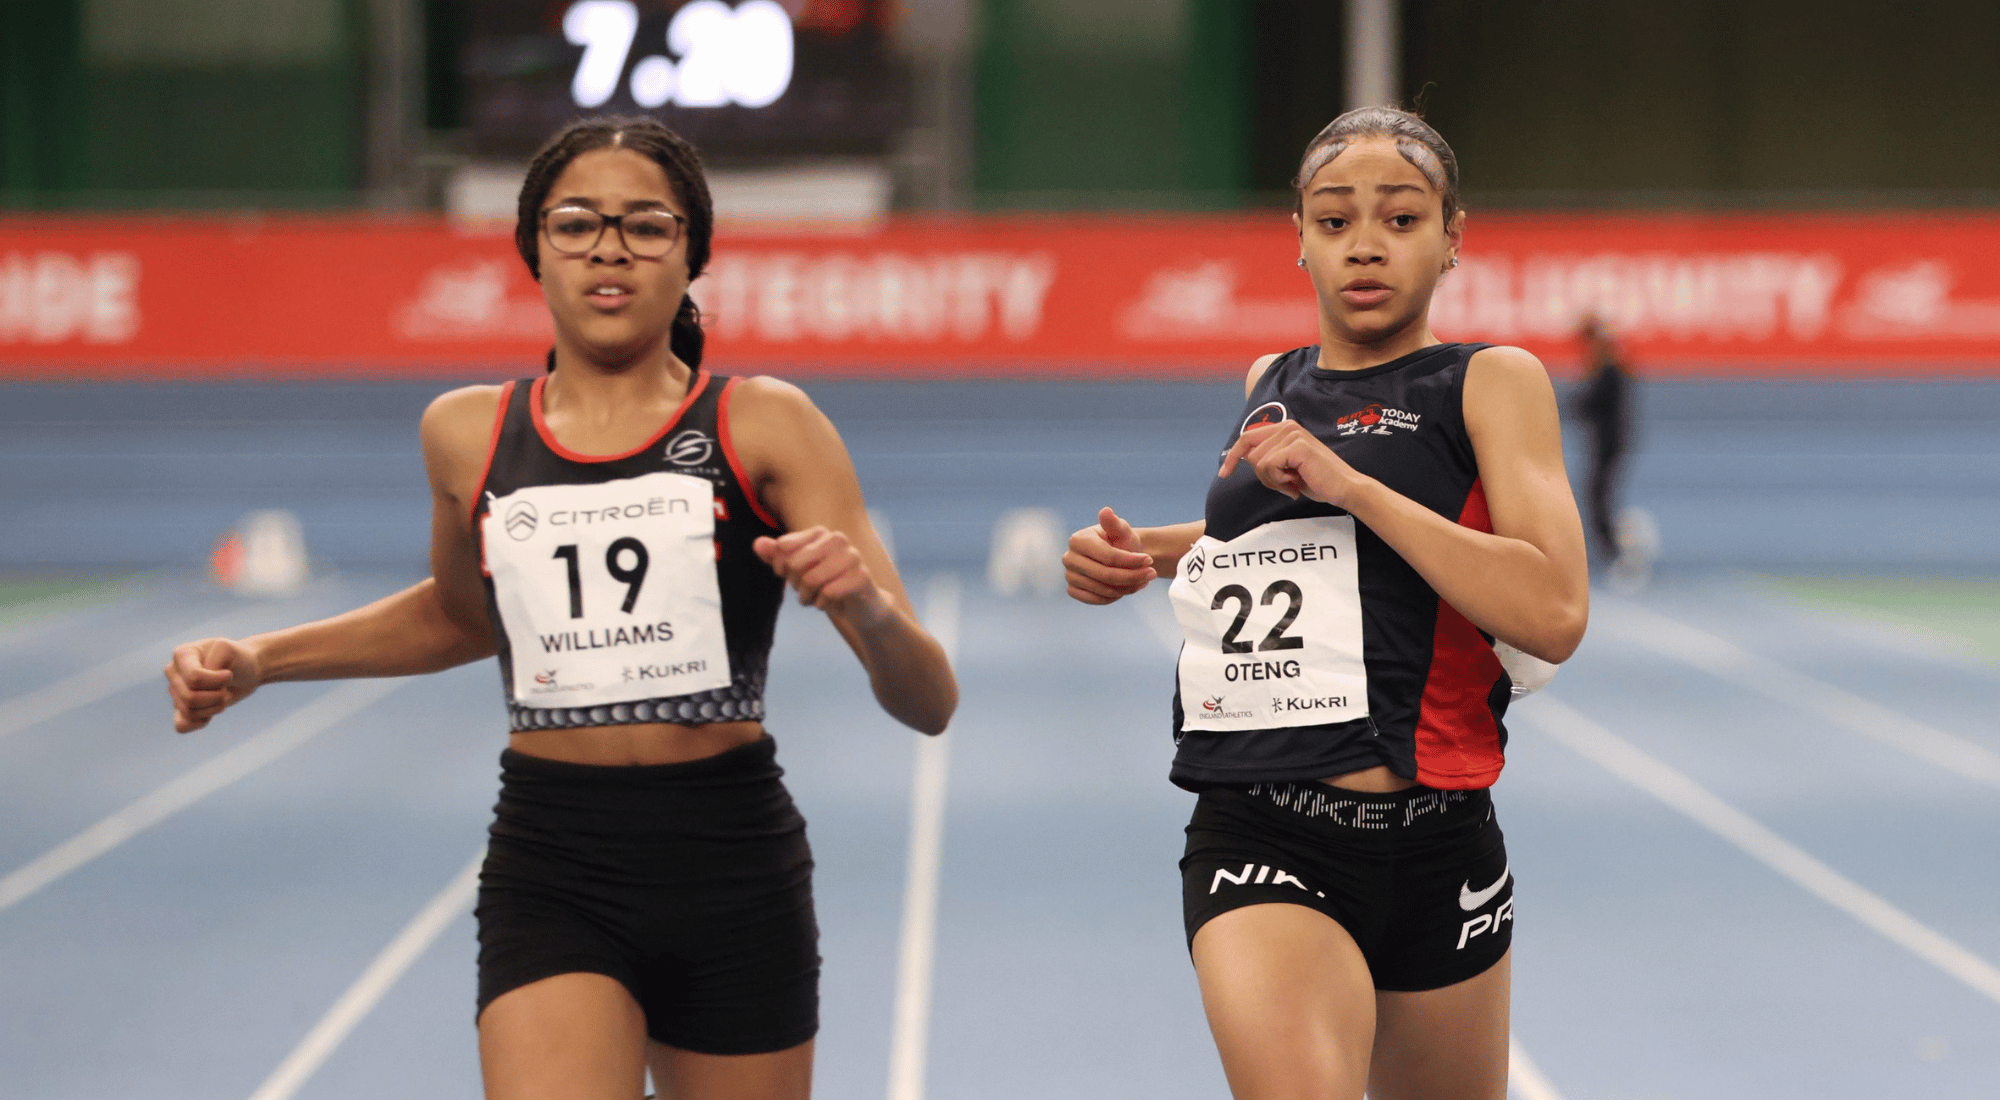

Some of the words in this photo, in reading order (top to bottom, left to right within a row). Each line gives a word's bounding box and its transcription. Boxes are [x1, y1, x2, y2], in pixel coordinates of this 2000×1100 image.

[0, 253, 141, 342] IDE
[1378, 416, 1418, 432] Academy
[1381, 408, 1421, 423] TODAY
[552, 536, 649, 619] 19
[1210, 579, 1304, 654] 22
[540, 622, 674, 653] WILLIAMS
[639, 660, 708, 681] KUKRI
[1225, 660, 1301, 682] OTENG
[1287, 696, 1348, 711] KUKRI
[1209, 863, 1326, 898] NIK
